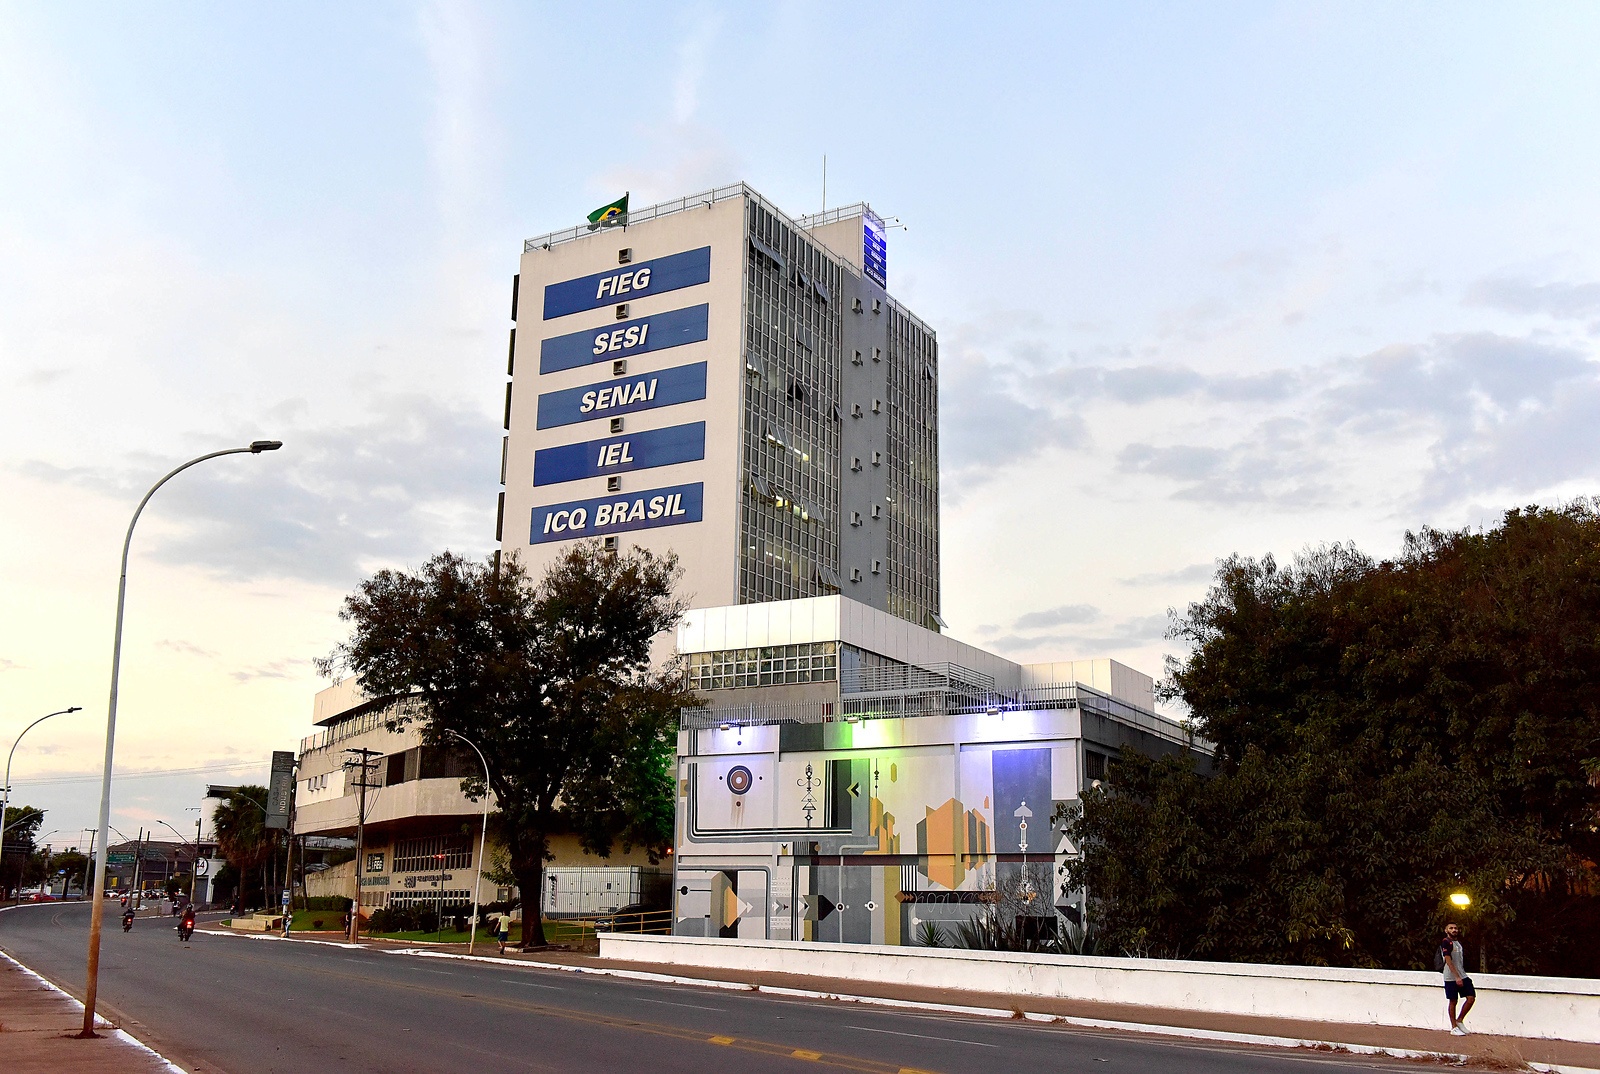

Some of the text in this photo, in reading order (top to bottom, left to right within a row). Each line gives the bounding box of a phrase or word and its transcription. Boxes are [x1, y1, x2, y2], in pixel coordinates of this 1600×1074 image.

[596, 268, 651, 299] FIEG
[592, 324, 649, 355] SESI
[580, 378, 658, 413] SENAI
[597, 442, 633, 467] IEL
[543, 493, 686, 534] ICQ BRASIL
